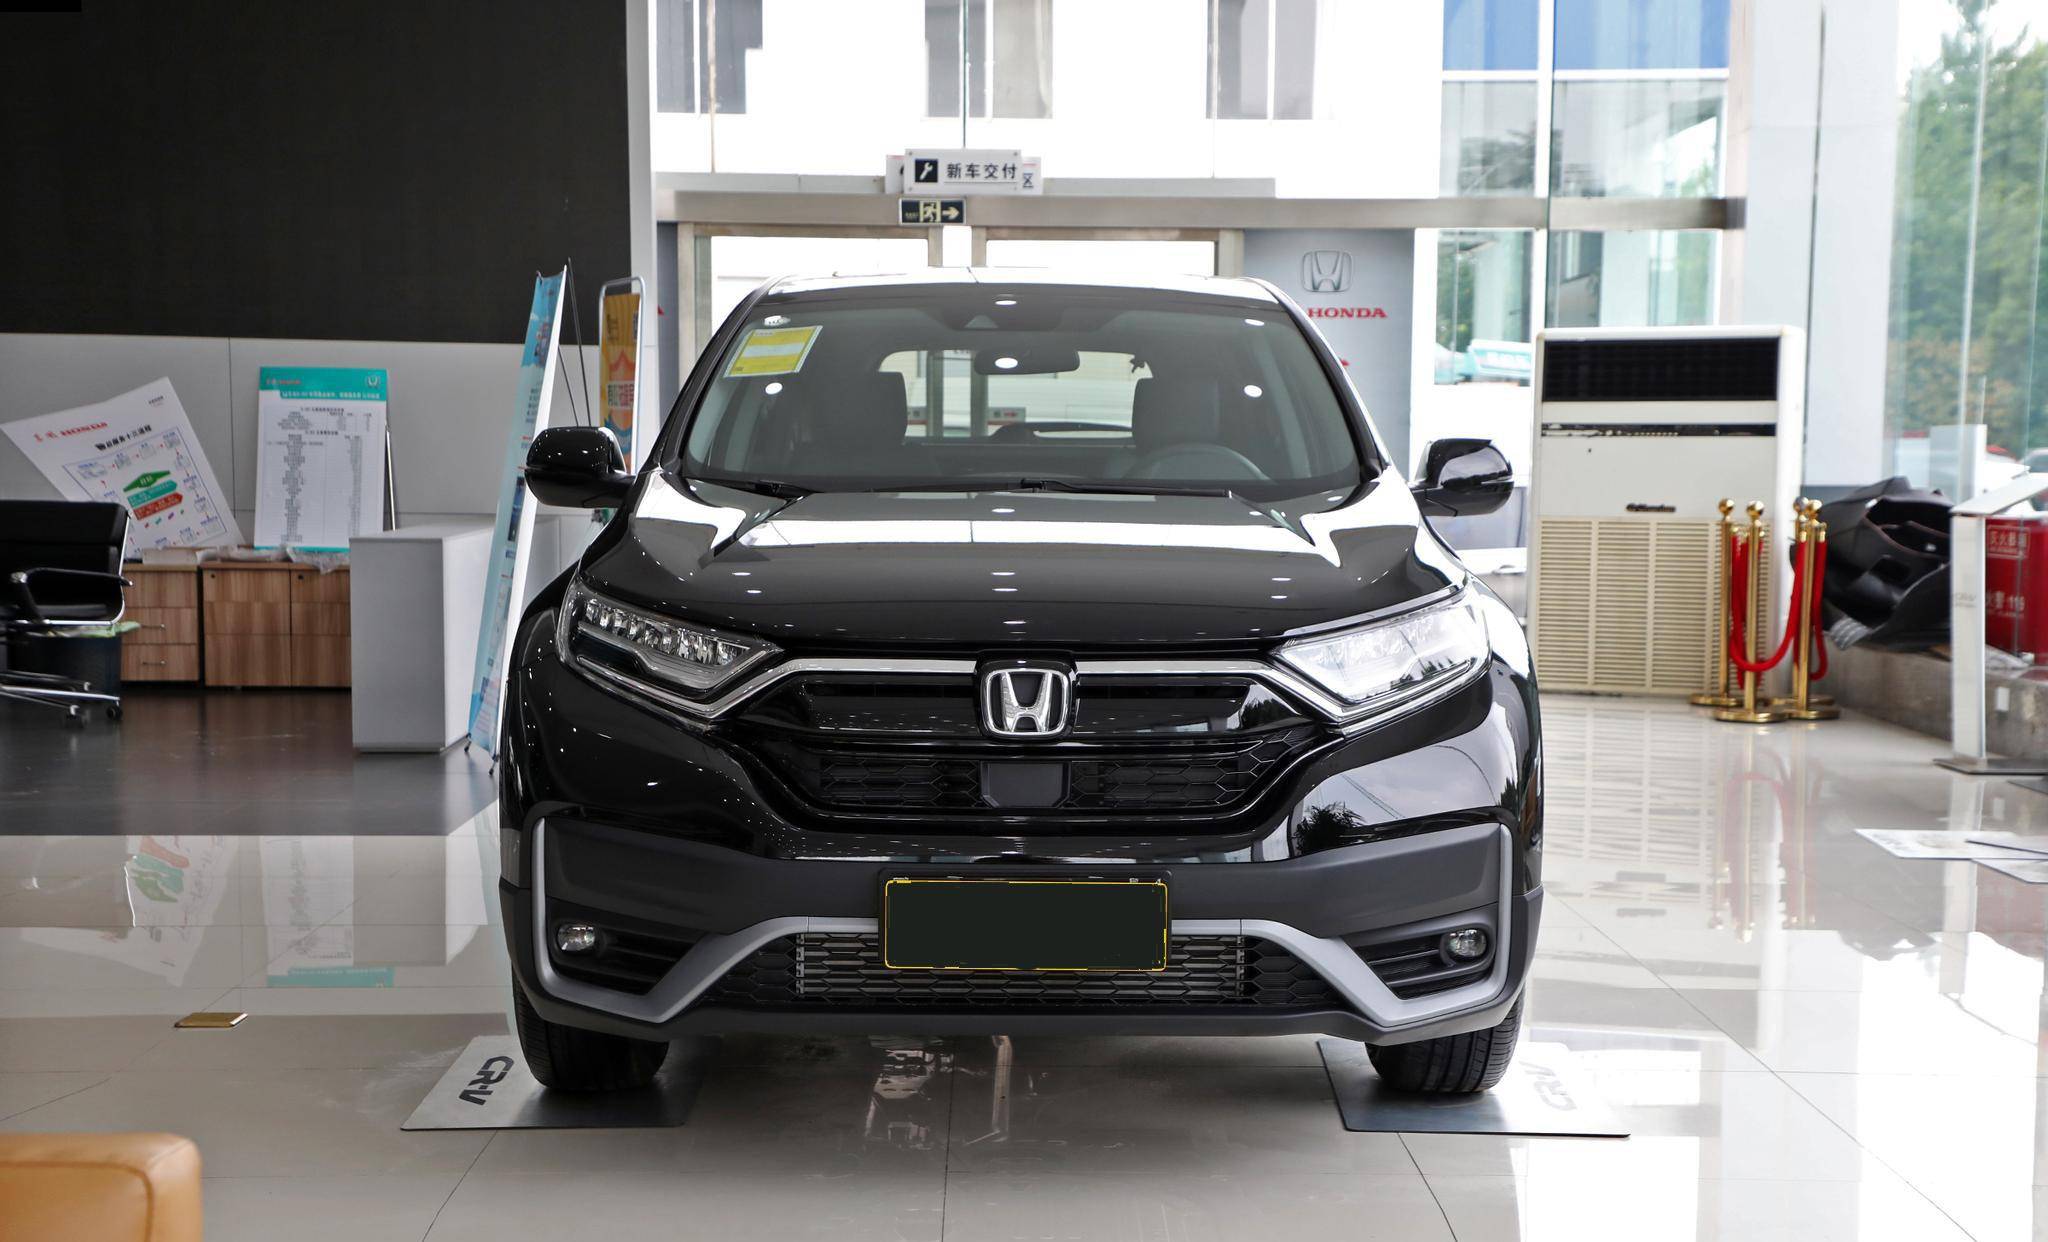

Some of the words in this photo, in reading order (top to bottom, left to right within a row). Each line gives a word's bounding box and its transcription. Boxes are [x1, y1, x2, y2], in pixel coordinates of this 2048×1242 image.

[947, 163, 1017, 180] 新车交付
[1022, 173, 1035, 188] 区
[1307, 307, 1388, 318] HONDA
